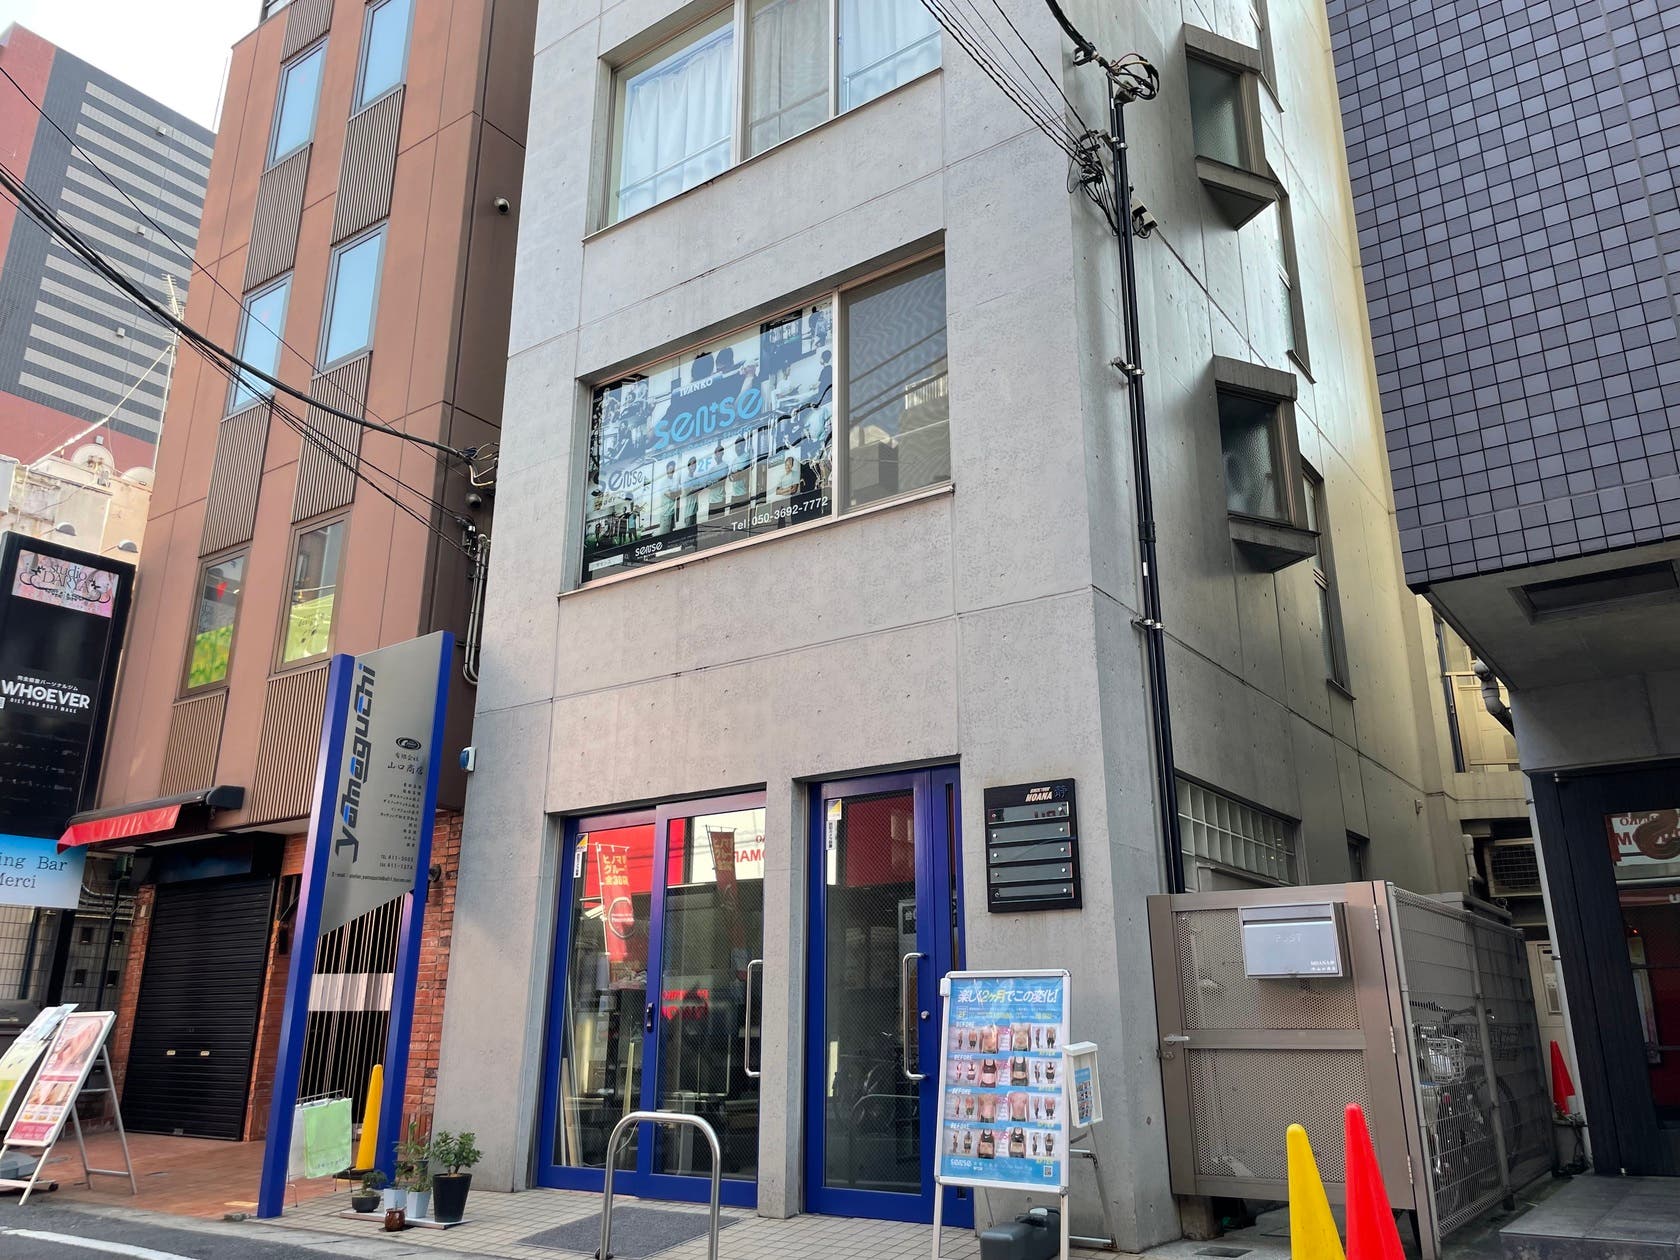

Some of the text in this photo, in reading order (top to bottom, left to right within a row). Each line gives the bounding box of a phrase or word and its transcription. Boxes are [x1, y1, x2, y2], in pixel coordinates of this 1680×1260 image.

[751, 496, 828, 526] 050-3692-7772
[1, 679, 91, 709] WHOEVER
[37, 856, 68, 871] Bar
